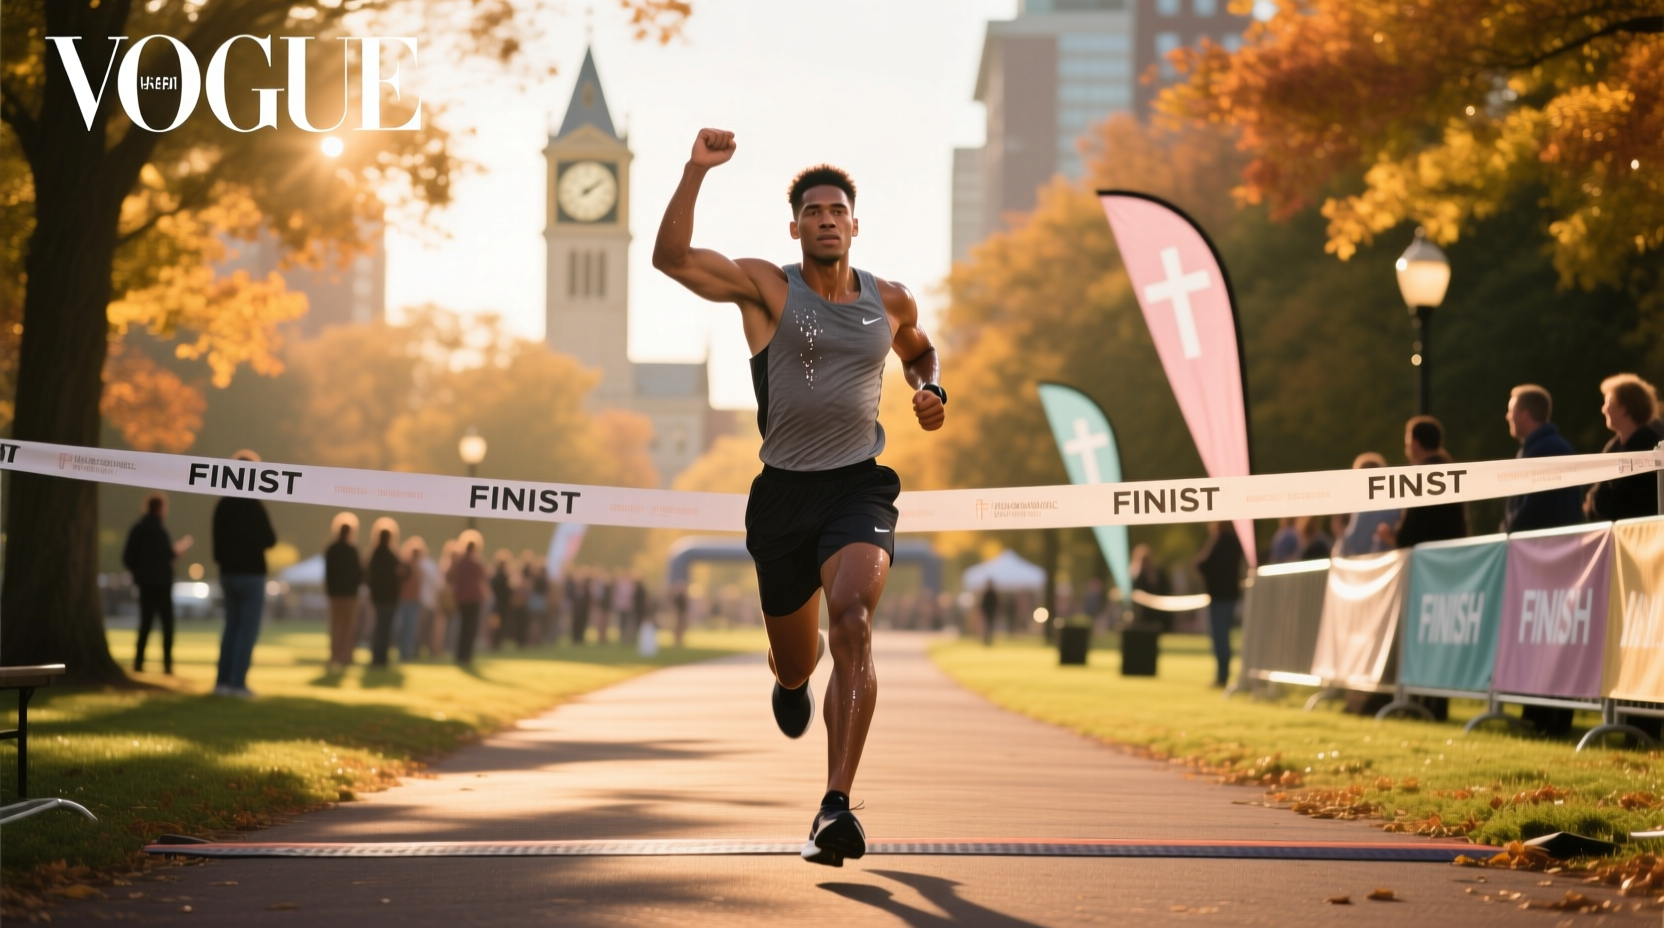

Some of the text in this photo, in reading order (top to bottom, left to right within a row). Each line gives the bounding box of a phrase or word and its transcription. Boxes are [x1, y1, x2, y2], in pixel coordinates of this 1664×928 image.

[188, 463, 302, 495] FINIST
[1368, 470, 1467, 500] FINST
[469, 484, 581, 514] FINIST
[1113, 486, 1220, 515] FINIST
[1417, 590, 1485, 645] FINISH
[1518, 587, 1593, 646] FINISH
